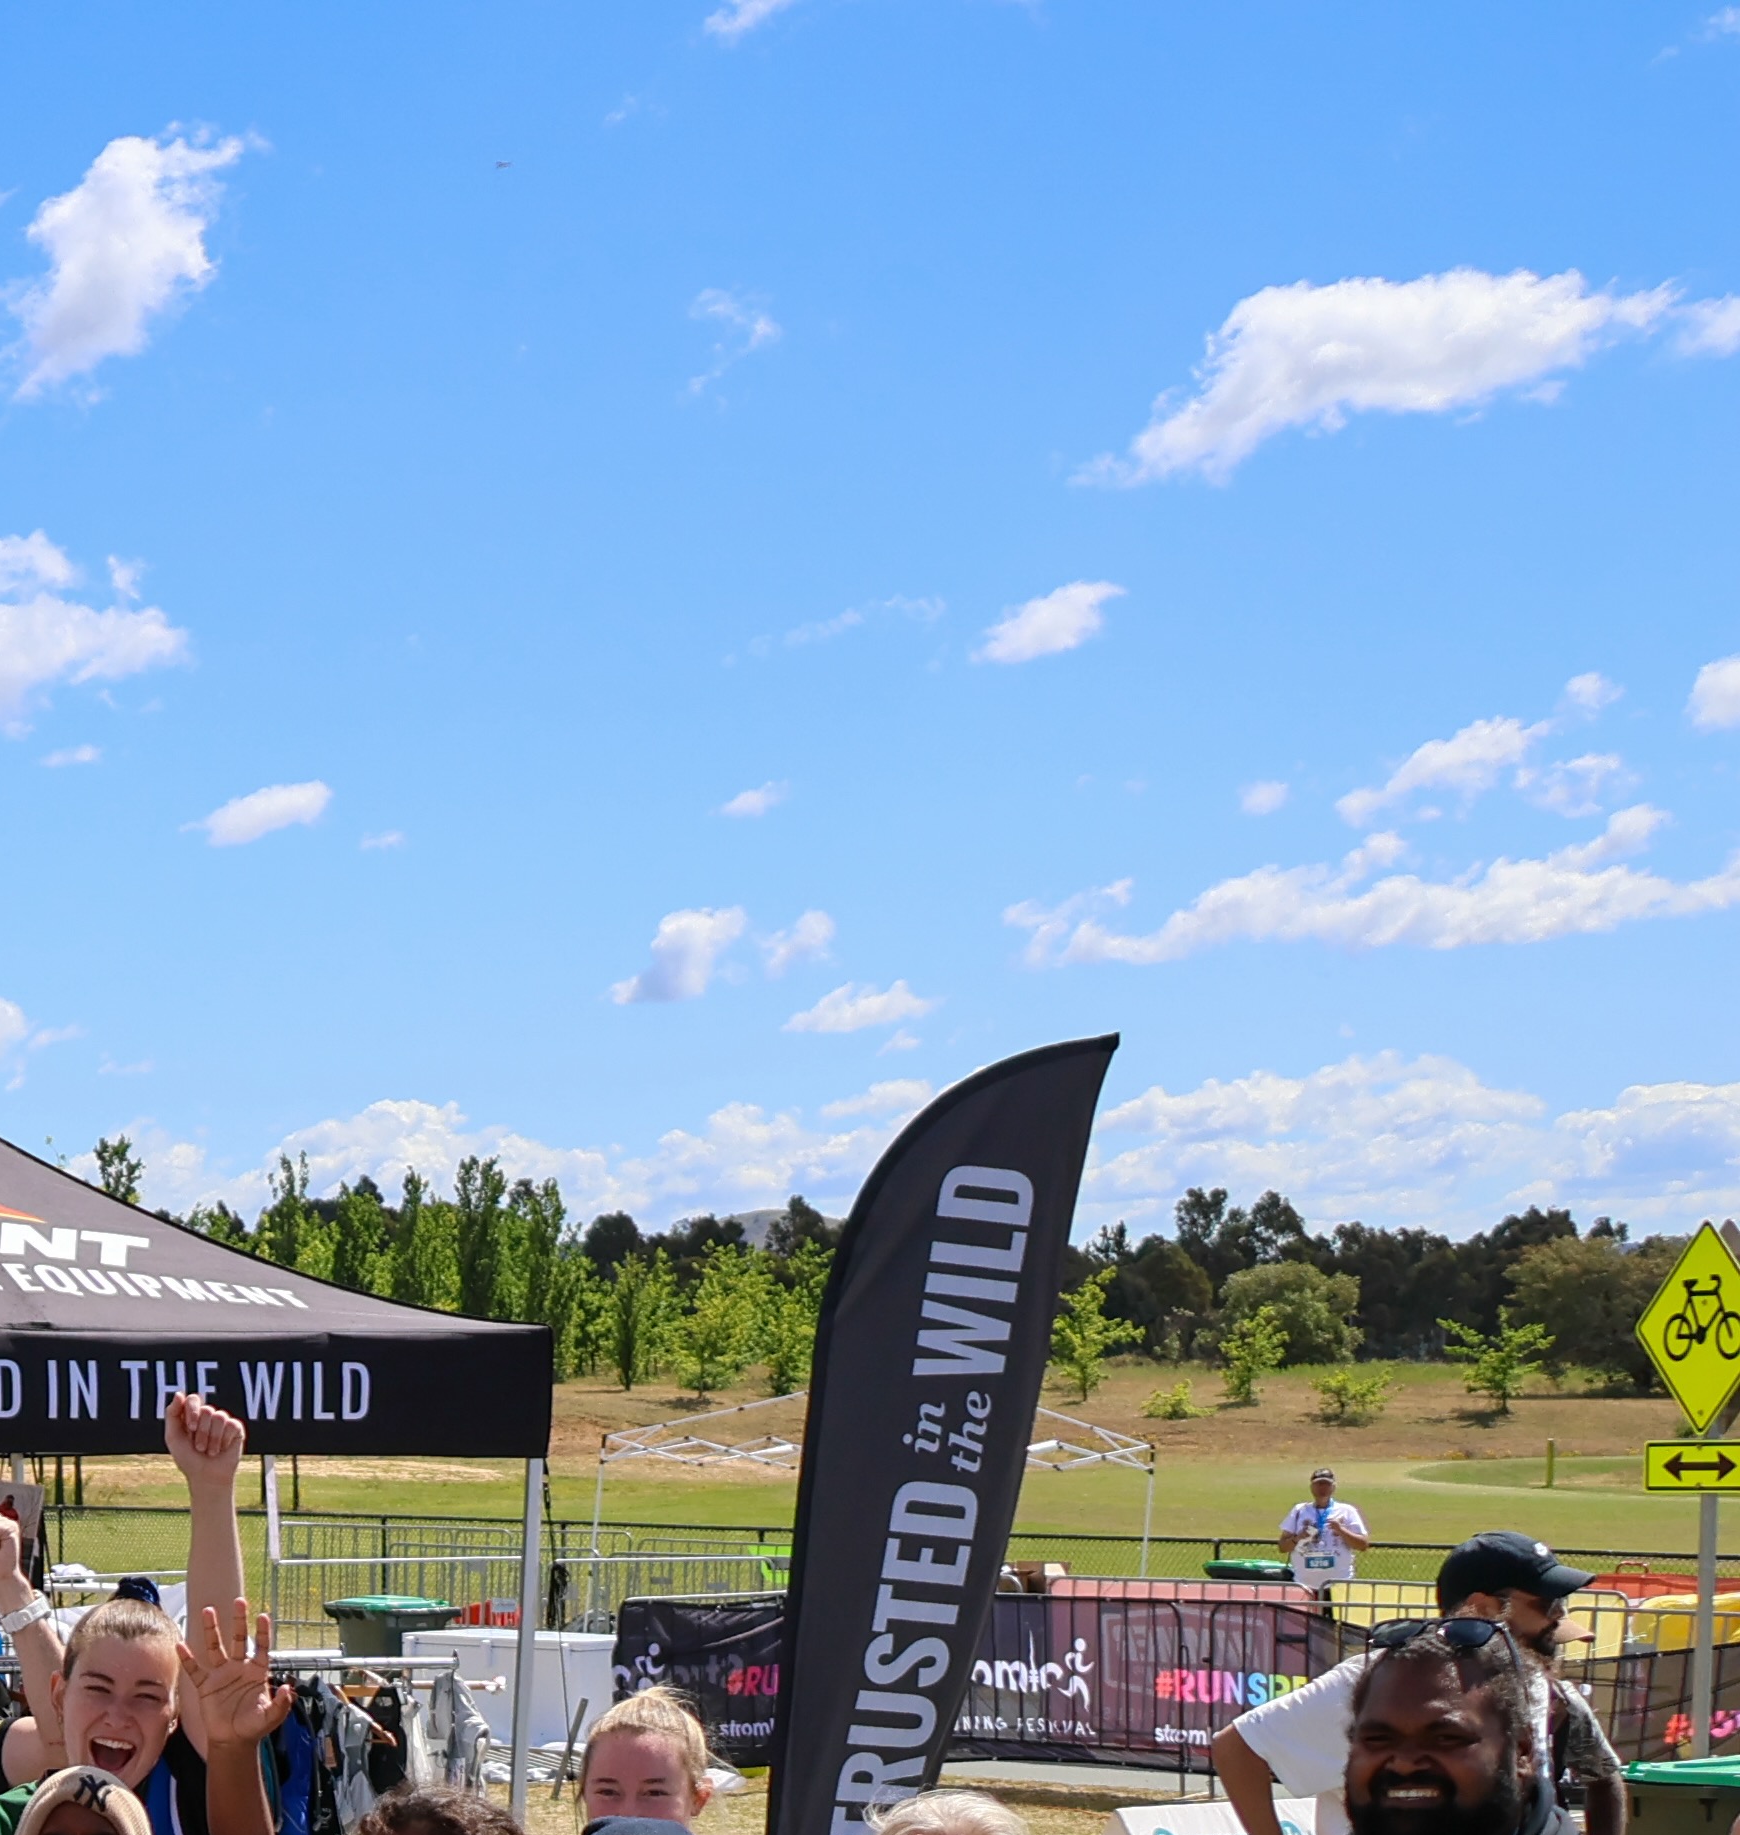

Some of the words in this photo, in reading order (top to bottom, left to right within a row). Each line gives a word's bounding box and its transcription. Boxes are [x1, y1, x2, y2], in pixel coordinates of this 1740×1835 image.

[2, 1261, 310, 1310] EQUIPMENT
[911, 1163, 1035, 1378] WILD
[48, 1359, 99, 1421] IN
[240, 1361, 371, 1422] WILD
[904, 1401, 947, 1455] in
[951, 1390, 992, 1474] the
